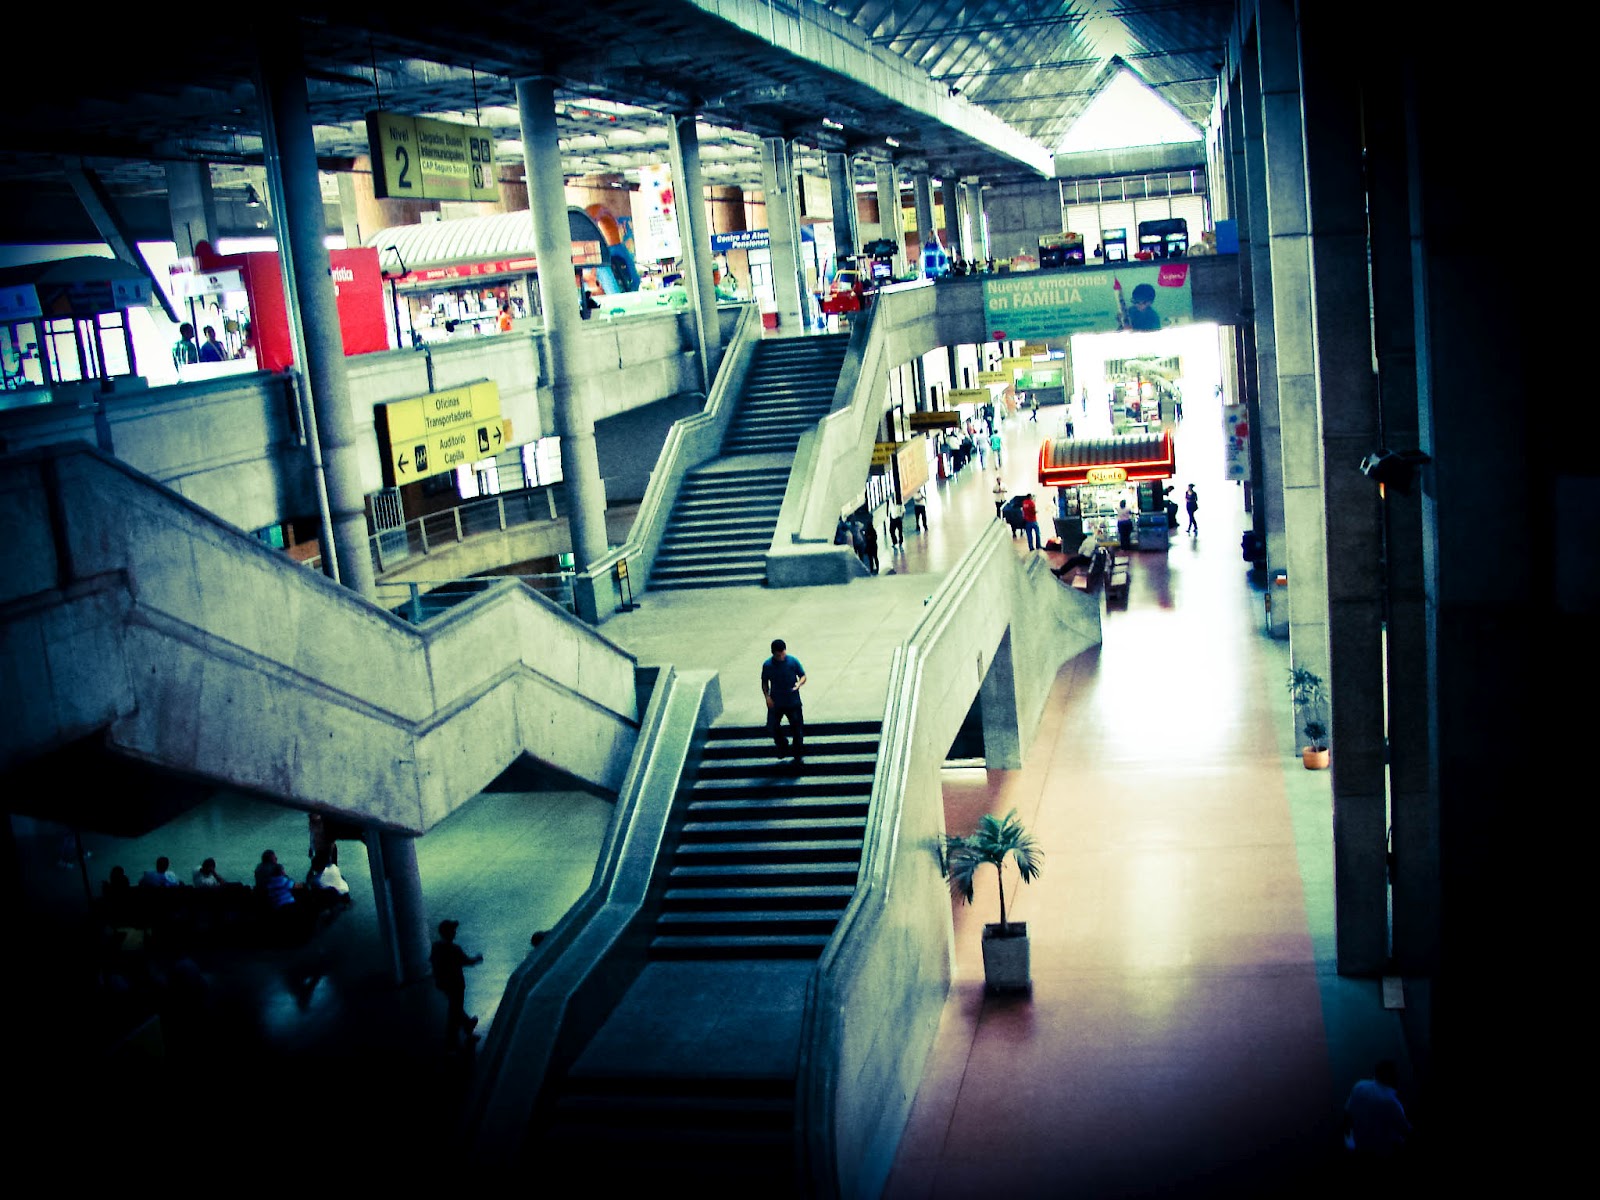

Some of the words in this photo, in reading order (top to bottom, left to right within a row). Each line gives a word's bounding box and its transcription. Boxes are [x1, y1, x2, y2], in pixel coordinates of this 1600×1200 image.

[390, 126, 409, 142] Nivel
[395, 146, 412, 189] 2
[716, 233, 741, 244] Centro
[741, 232, 751, 241] de
[987, 279, 1034, 294] Nuevas
[1038, 273, 1108, 290] emociones
[988, 297, 1008, 310] en
[1012, 288, 1083, 309] FAMILIA
[435, 397, 460, 410] Oficinas
[425, 409, 472, 428] Transportadores
[440, 433, 466, 450] Auditorio
[444, 449, 465, 465] Capilla
